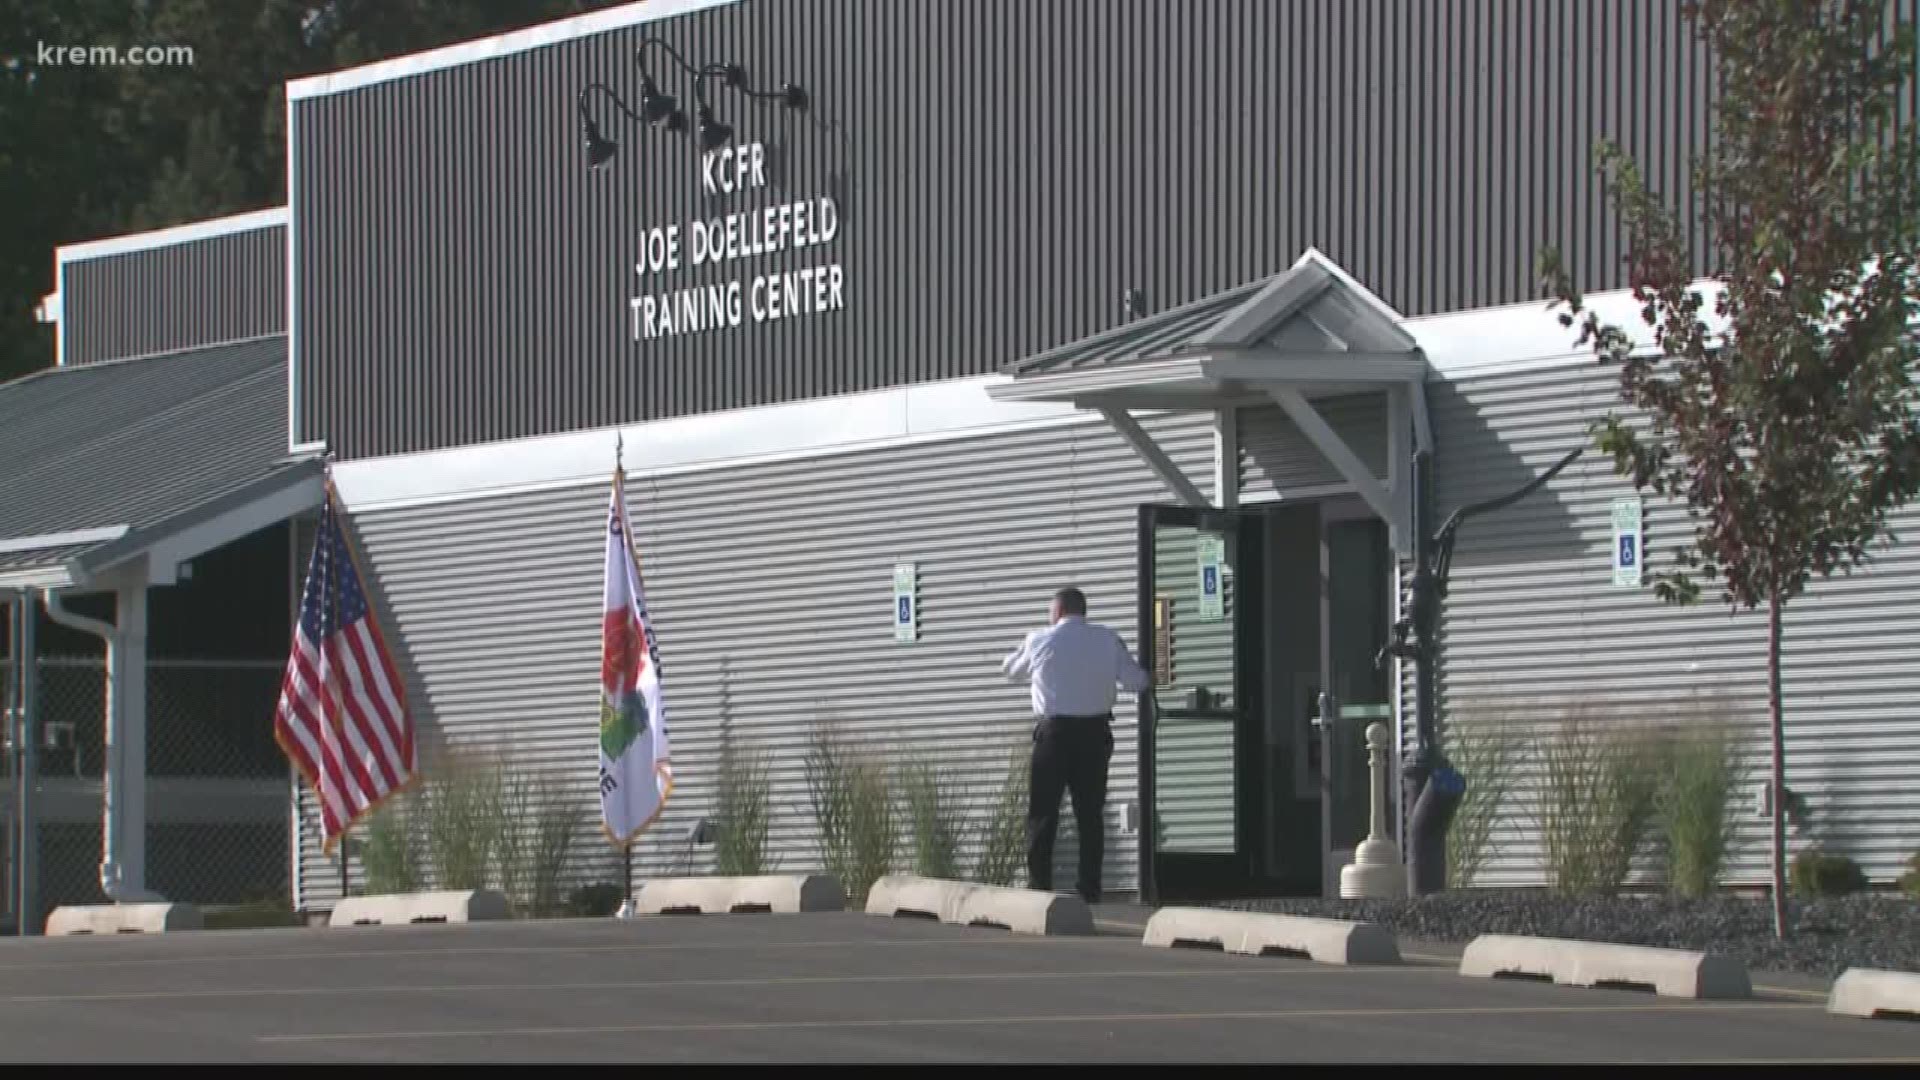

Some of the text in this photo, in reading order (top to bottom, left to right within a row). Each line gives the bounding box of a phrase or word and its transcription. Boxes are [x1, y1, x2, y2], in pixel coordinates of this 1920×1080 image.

[702, 142, 765, 194] KCFR
[636, 197, 838, 276] JOE DOELLEFELD
[630, 264, 844, 341] TRAINING CENTER
